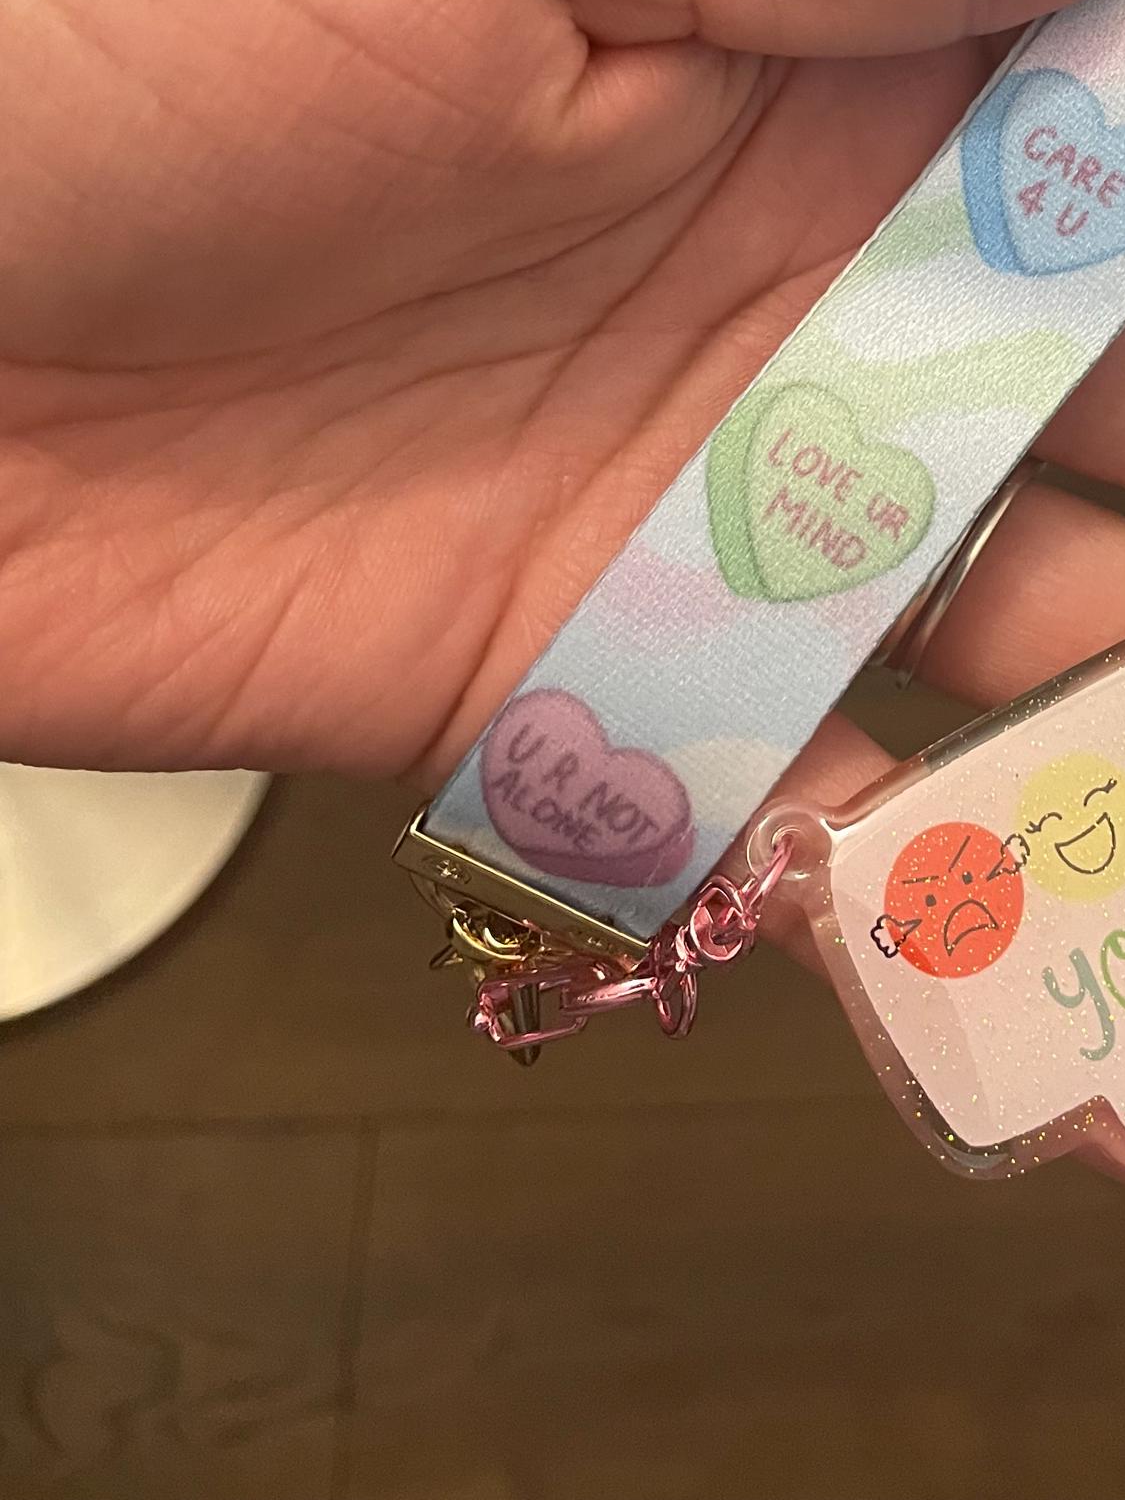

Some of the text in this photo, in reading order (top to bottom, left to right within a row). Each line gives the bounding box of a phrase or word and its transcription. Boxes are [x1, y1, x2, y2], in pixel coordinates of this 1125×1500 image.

[1016, 180, 1091, 237] 4 U
[767, 428, 912, 542] LOVE UR
[760, 484, 867, 572] MIND
[490, 769, 605, 852] ALONE
[579, 781, 661, 846] NOT
